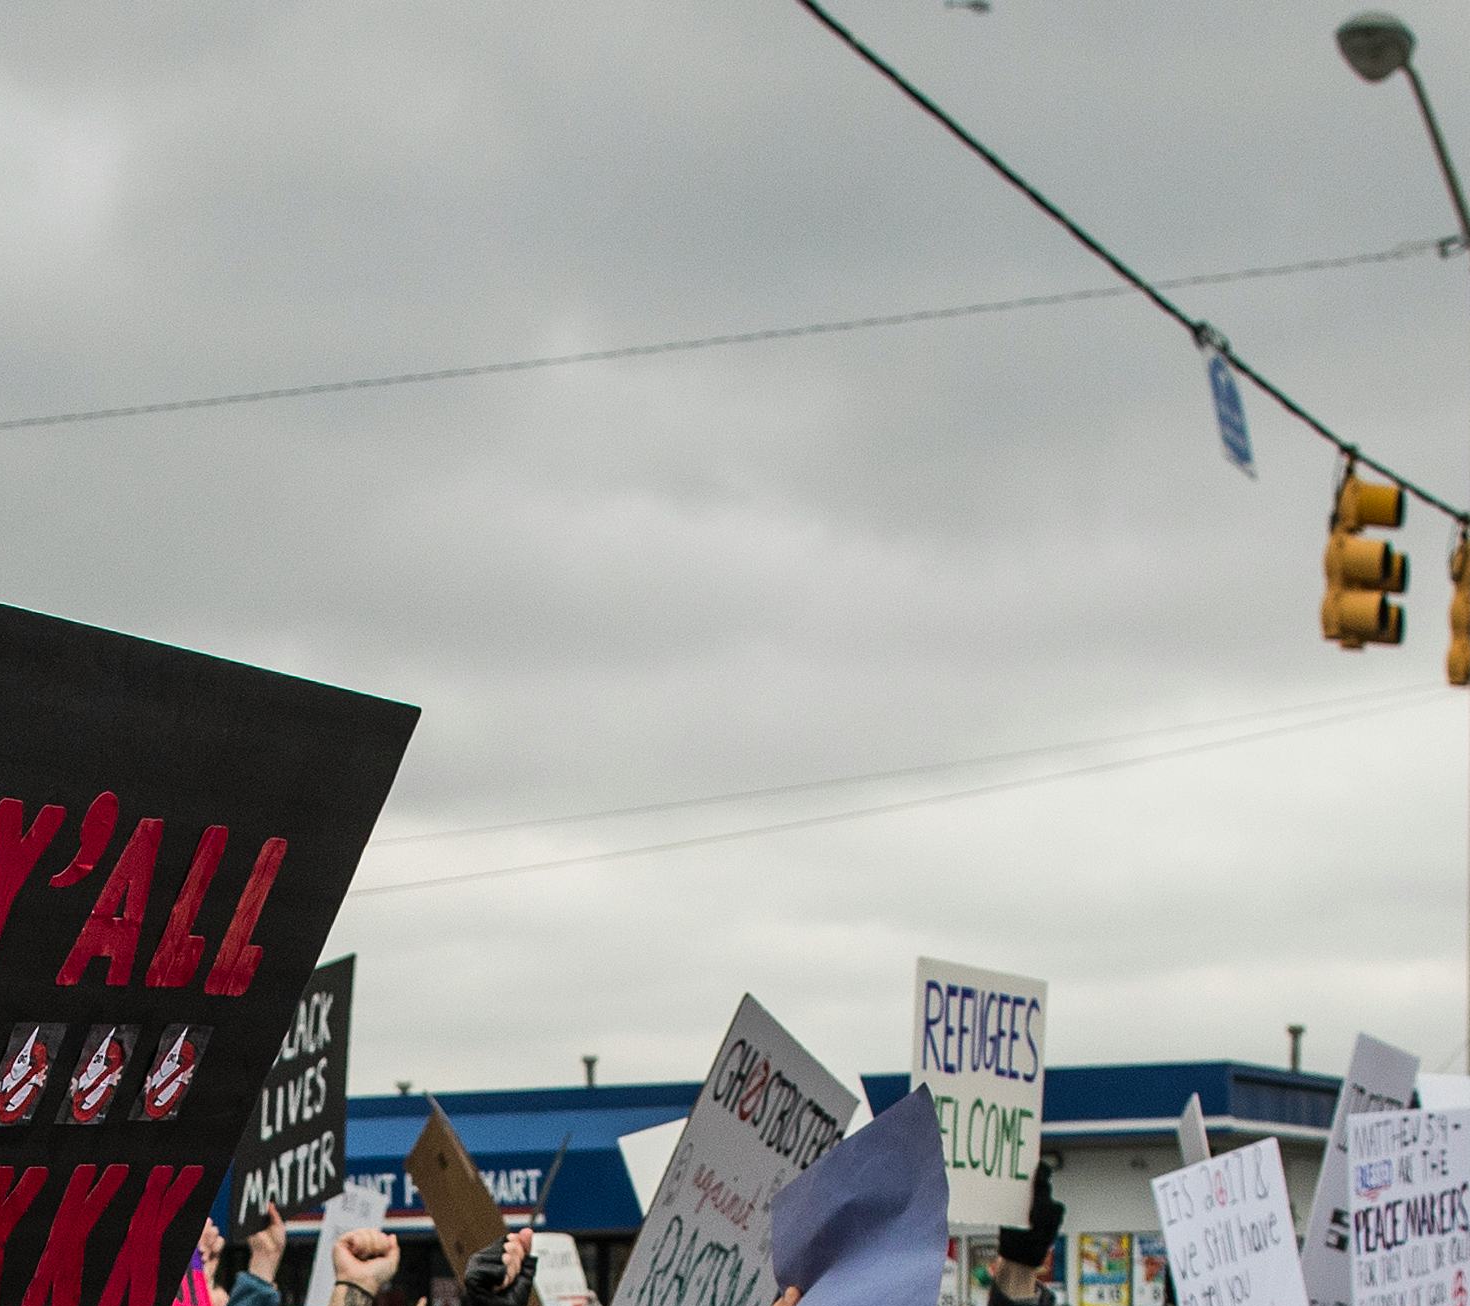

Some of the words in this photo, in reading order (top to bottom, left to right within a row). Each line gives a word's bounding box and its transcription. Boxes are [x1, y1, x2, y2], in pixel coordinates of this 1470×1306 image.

[272, 991, 334, 1068] LACK
[922, 979, 1041, 1083] REFUGEES
[261, 1057, 327, 1142] LIVES
[935, 1096, 1034, 1181] ELCOME
[237, 1130, 337, 1226] MATTER
[1354, 1181, 1470, 1256] PEACEMAKERS
